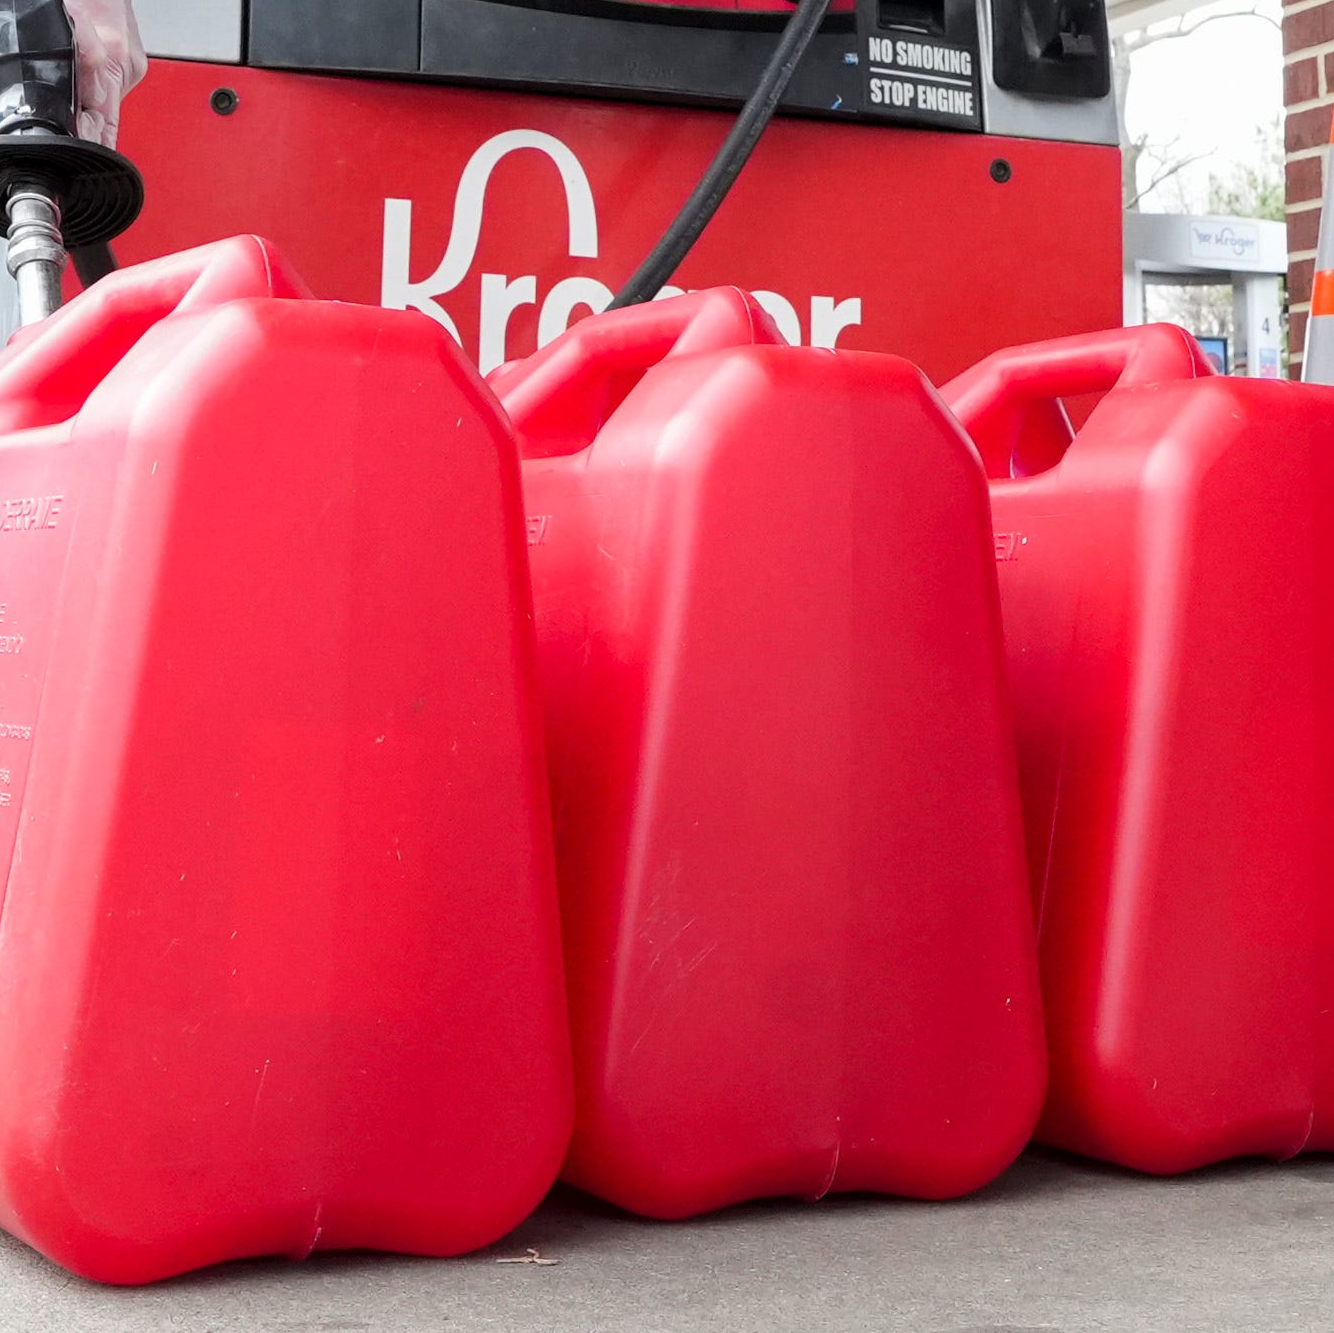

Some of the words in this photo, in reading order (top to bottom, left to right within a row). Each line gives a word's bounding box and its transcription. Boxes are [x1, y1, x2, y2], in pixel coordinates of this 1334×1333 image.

[869, 37, 893, 63] NO
[896, 41, 972, 76] SMOKING
[870, 78, 915, 107] STOP
[917, 85, 973, 116] ENGINE
[380, 129, 861, 378] Kror
[1215, 227, 1256, 255] Kroger
[1261, 318, 1271, 336] 4
